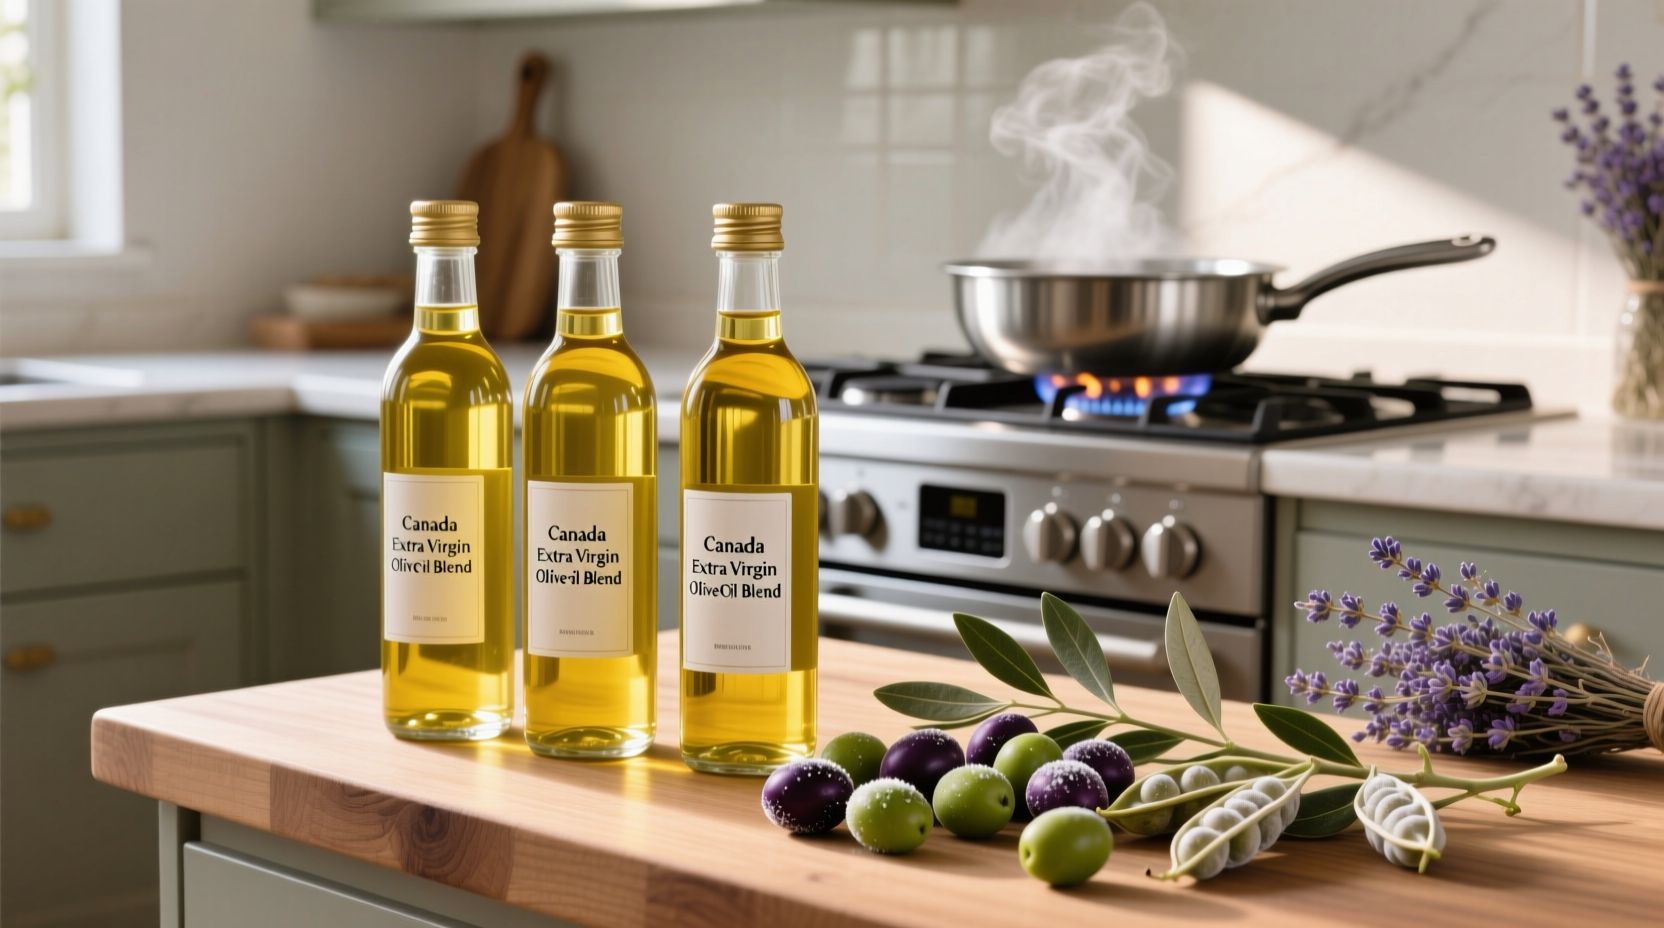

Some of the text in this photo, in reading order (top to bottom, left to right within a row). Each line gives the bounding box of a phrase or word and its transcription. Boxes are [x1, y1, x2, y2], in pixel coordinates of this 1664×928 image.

[402, 515, 457, 531] Canada
[548, 525, 606, 541] Canada
[392, 537, 470, 557] Extra Virgin
[704, 535, 764, 553] Canada
[537, 548, 619, 568] Extra Virgin
[434, 560, 472, 573] Blend
[692, 559, 776, 580] Extra Virgin
[584, 570, 621, 584] Blend
[742, 583, 781, 598] Blend
